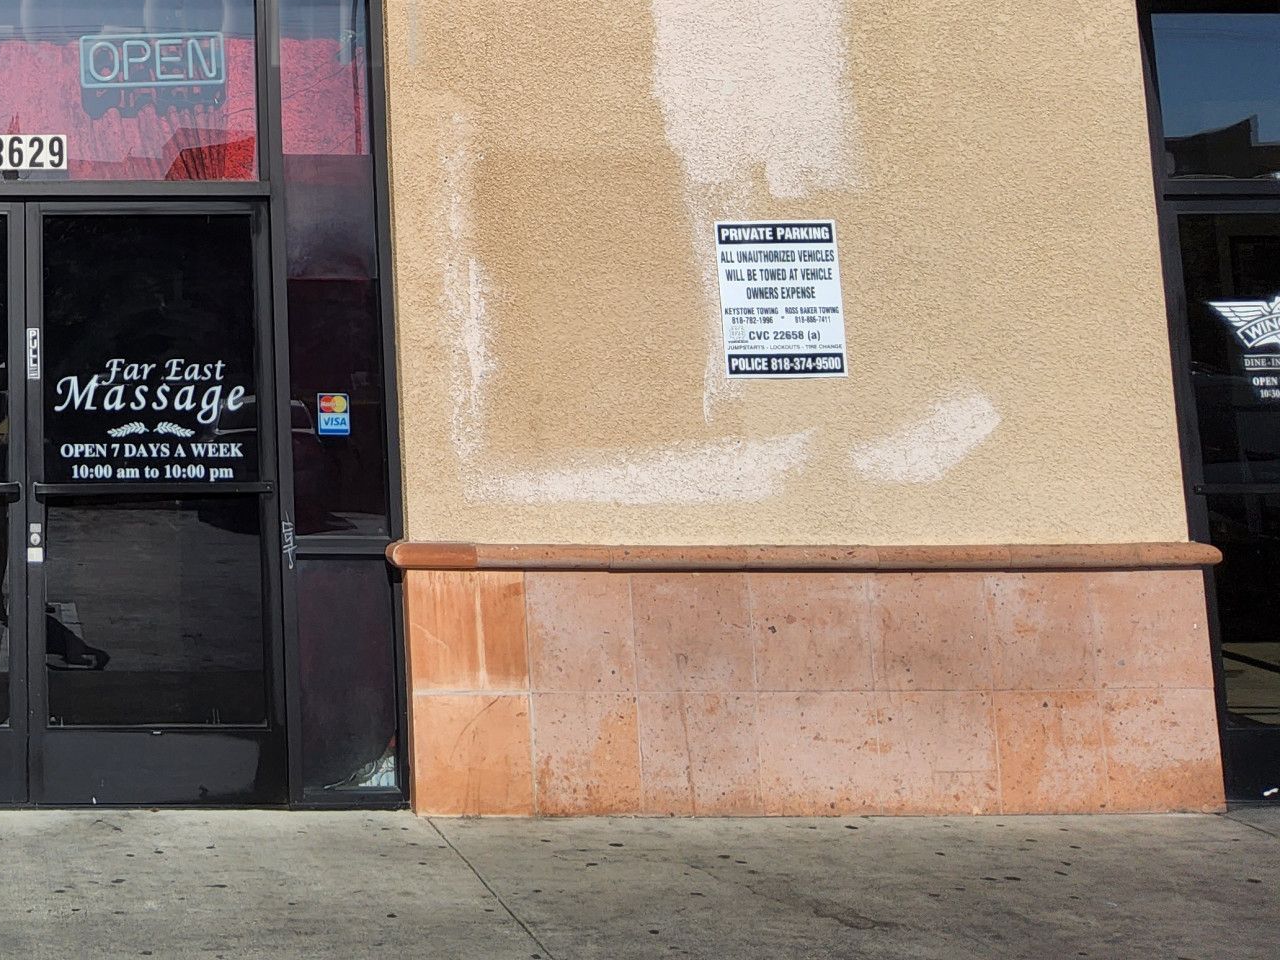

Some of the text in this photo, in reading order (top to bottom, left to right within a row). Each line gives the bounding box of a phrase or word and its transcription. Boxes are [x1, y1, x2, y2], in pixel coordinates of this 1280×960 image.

[89, 38, 217, 82] OPEN
[721, 226, 830, 241] PRIVATE PARKING
[720, 249, 835, 263] ALL UNAUTHORIZED VEHICLES
[725, 268, 833, 282] WILL BE TOWED AT VEHICLE
[746, 286, 816, 300] OWNERS EXPENSE
[724, 307, 779, 315] KEYSTONE TOWING
[800, 306, 818, 314] BAKER
[819, 306, 840, 314] TOWING
[748, 330, 821, 341] CVC 22658 (a)
[1245, 317, 1280, 340] WIN
[29, 330, 37, 367] PULL
[731, 356, 841, 371] POLICE 818-374-9500
[1243, 358, 1267, 367] DINE
[101, 358, 226, 385] Far East
[1252, 376, 1278, 386] OPEN
[54, 374, 245, 424] Massage
[323, 416, 347, 426] VISA
[60, 442, 244, 458] OPEN 7 DAYS A WEEK
[71, 464, 234, 482] 10:00 am to 10:00 pm
